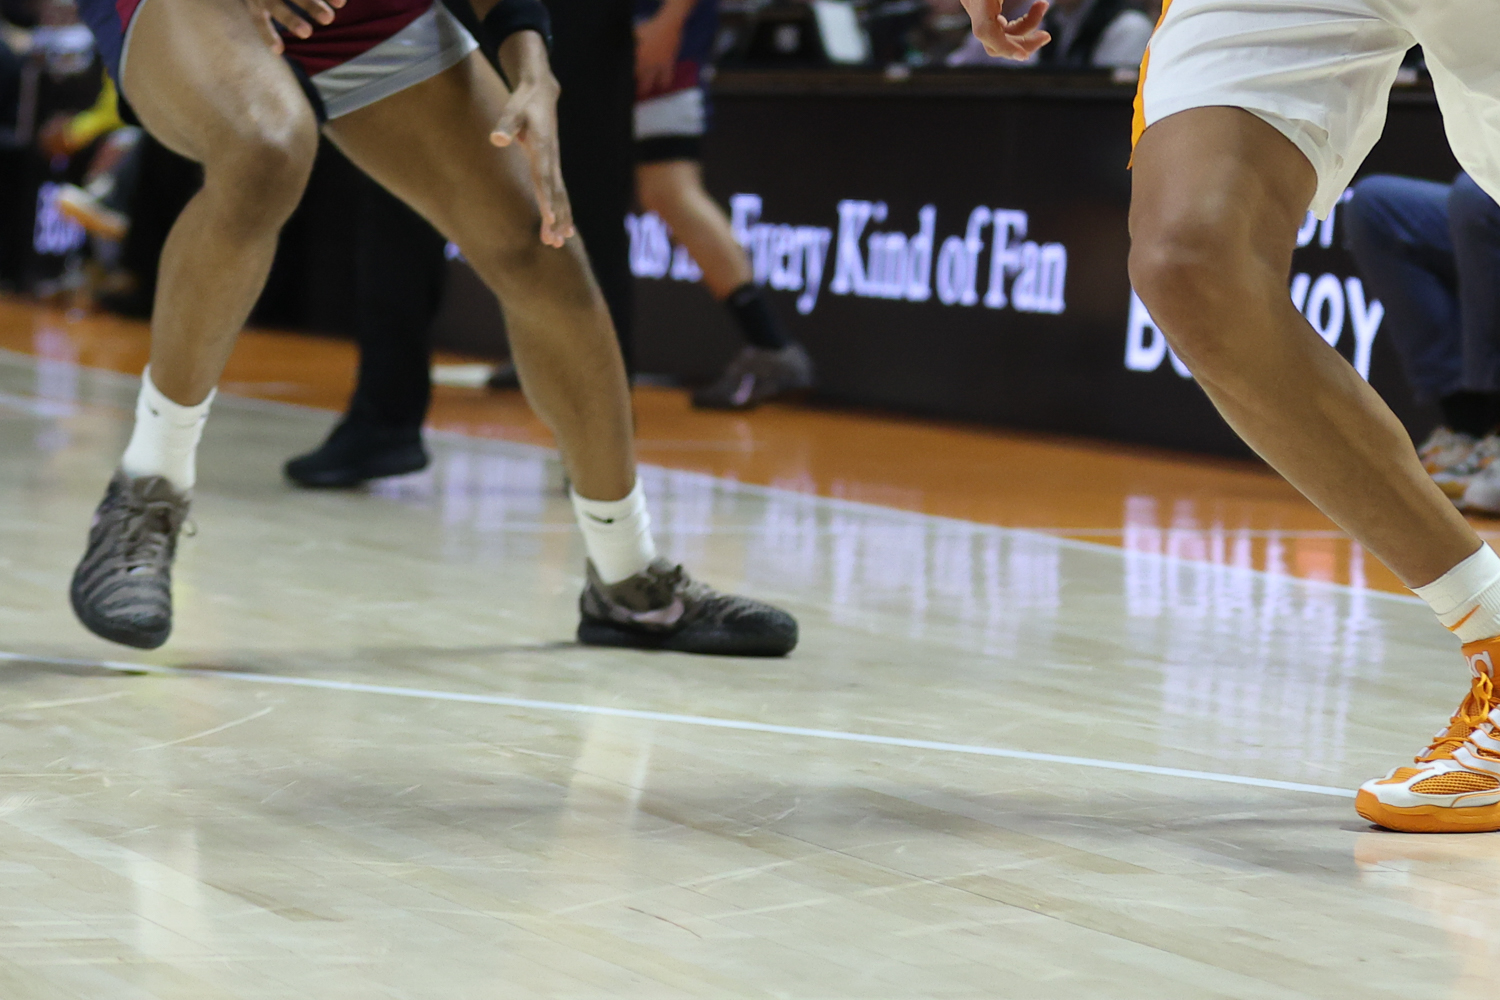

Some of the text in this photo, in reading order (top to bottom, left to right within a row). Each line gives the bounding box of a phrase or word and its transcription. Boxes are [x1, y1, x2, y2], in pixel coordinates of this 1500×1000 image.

[830, 198, 937, 302] Kind
[936, 205, 991, 307] of
[983, 208, 1068, 315] Fan
